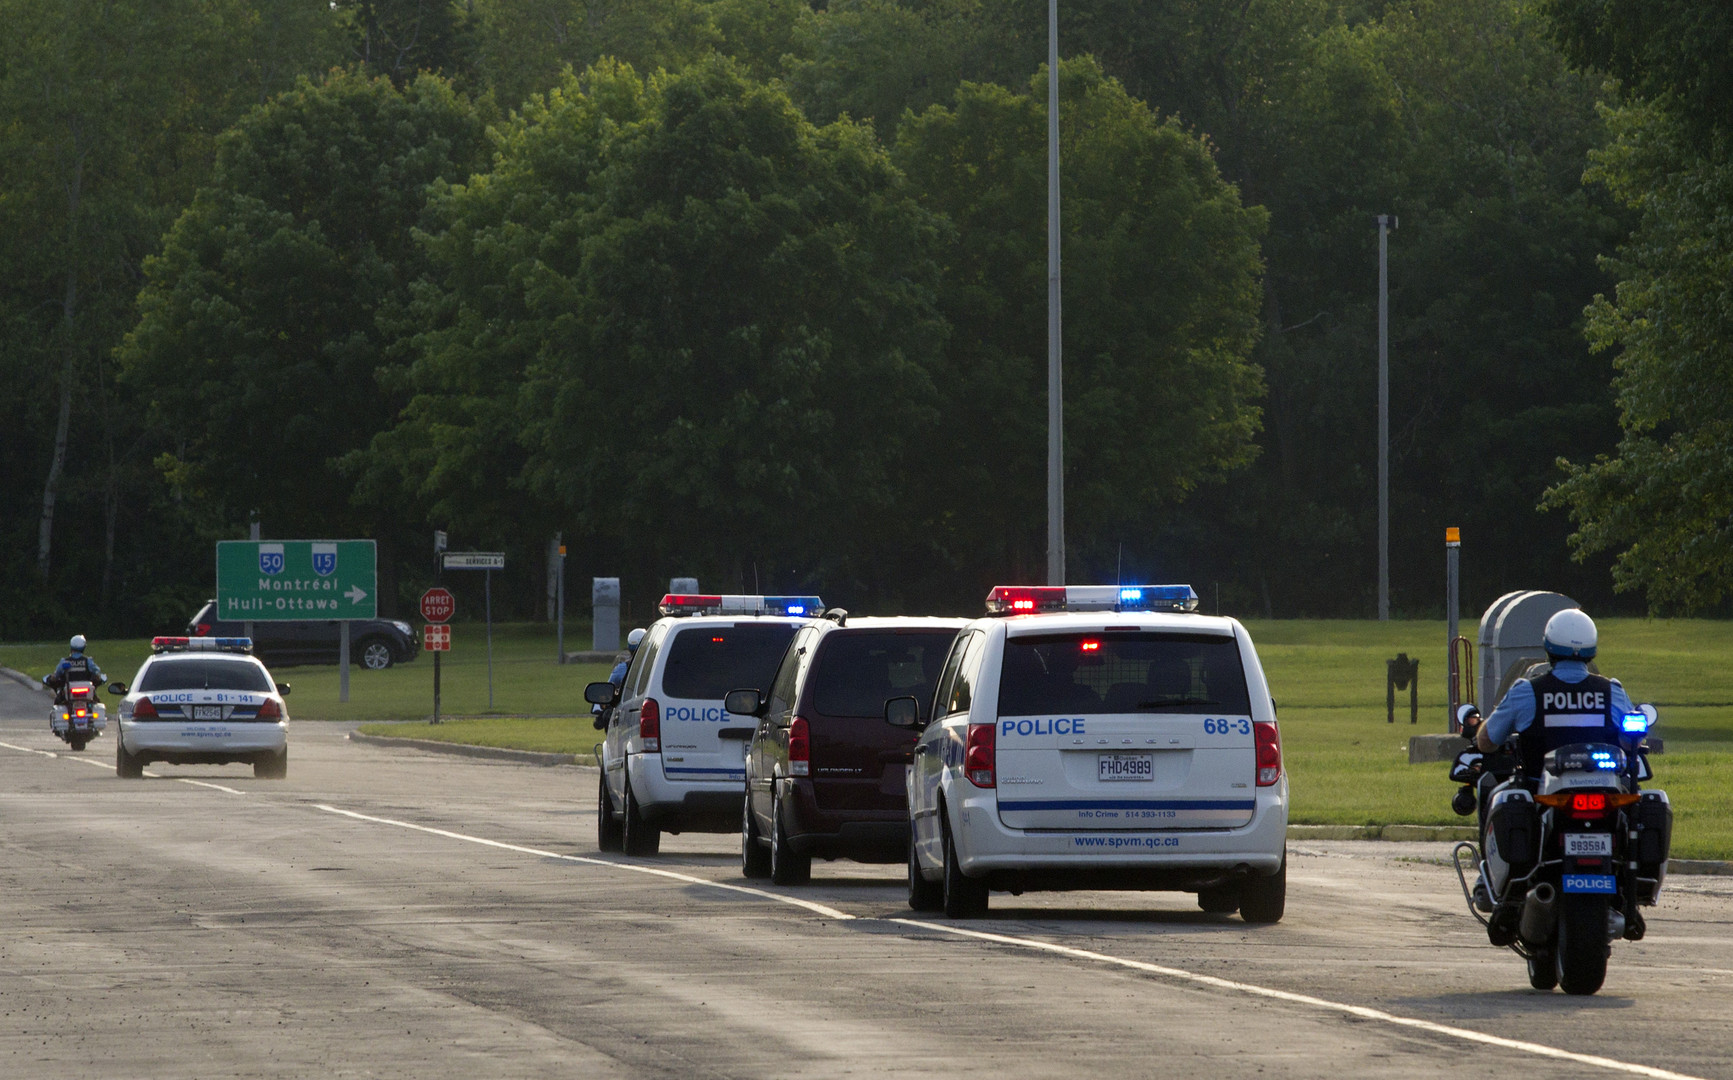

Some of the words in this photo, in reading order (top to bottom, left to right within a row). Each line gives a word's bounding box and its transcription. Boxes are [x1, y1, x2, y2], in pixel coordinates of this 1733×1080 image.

[263, 556, 281, 568] 50
[317, 556, 332, 568] 15
[465, 557, 492, 566] SERVICES
[258, 578, 338, 591] Montréal
[228, 597, 338, 610] Hull-Ottawa
[425, 606, 450, 616] STOP
[153, 693, 193, 703] POLICE
[239, 694, 253, 703] 141
[1543, 692, 1605, 710] POLICE
[666, 707, 731, 722] POLICE
[1002, 718, 1086, 737] POLICE
[1203, 718, 1251, 735] 68-3
[1100, 761, 1151, 775] FHD4989
[1075, 837, 1180, 849] www.spvm.qc.ca
[1566, 878, 1613, 889] POLICE
